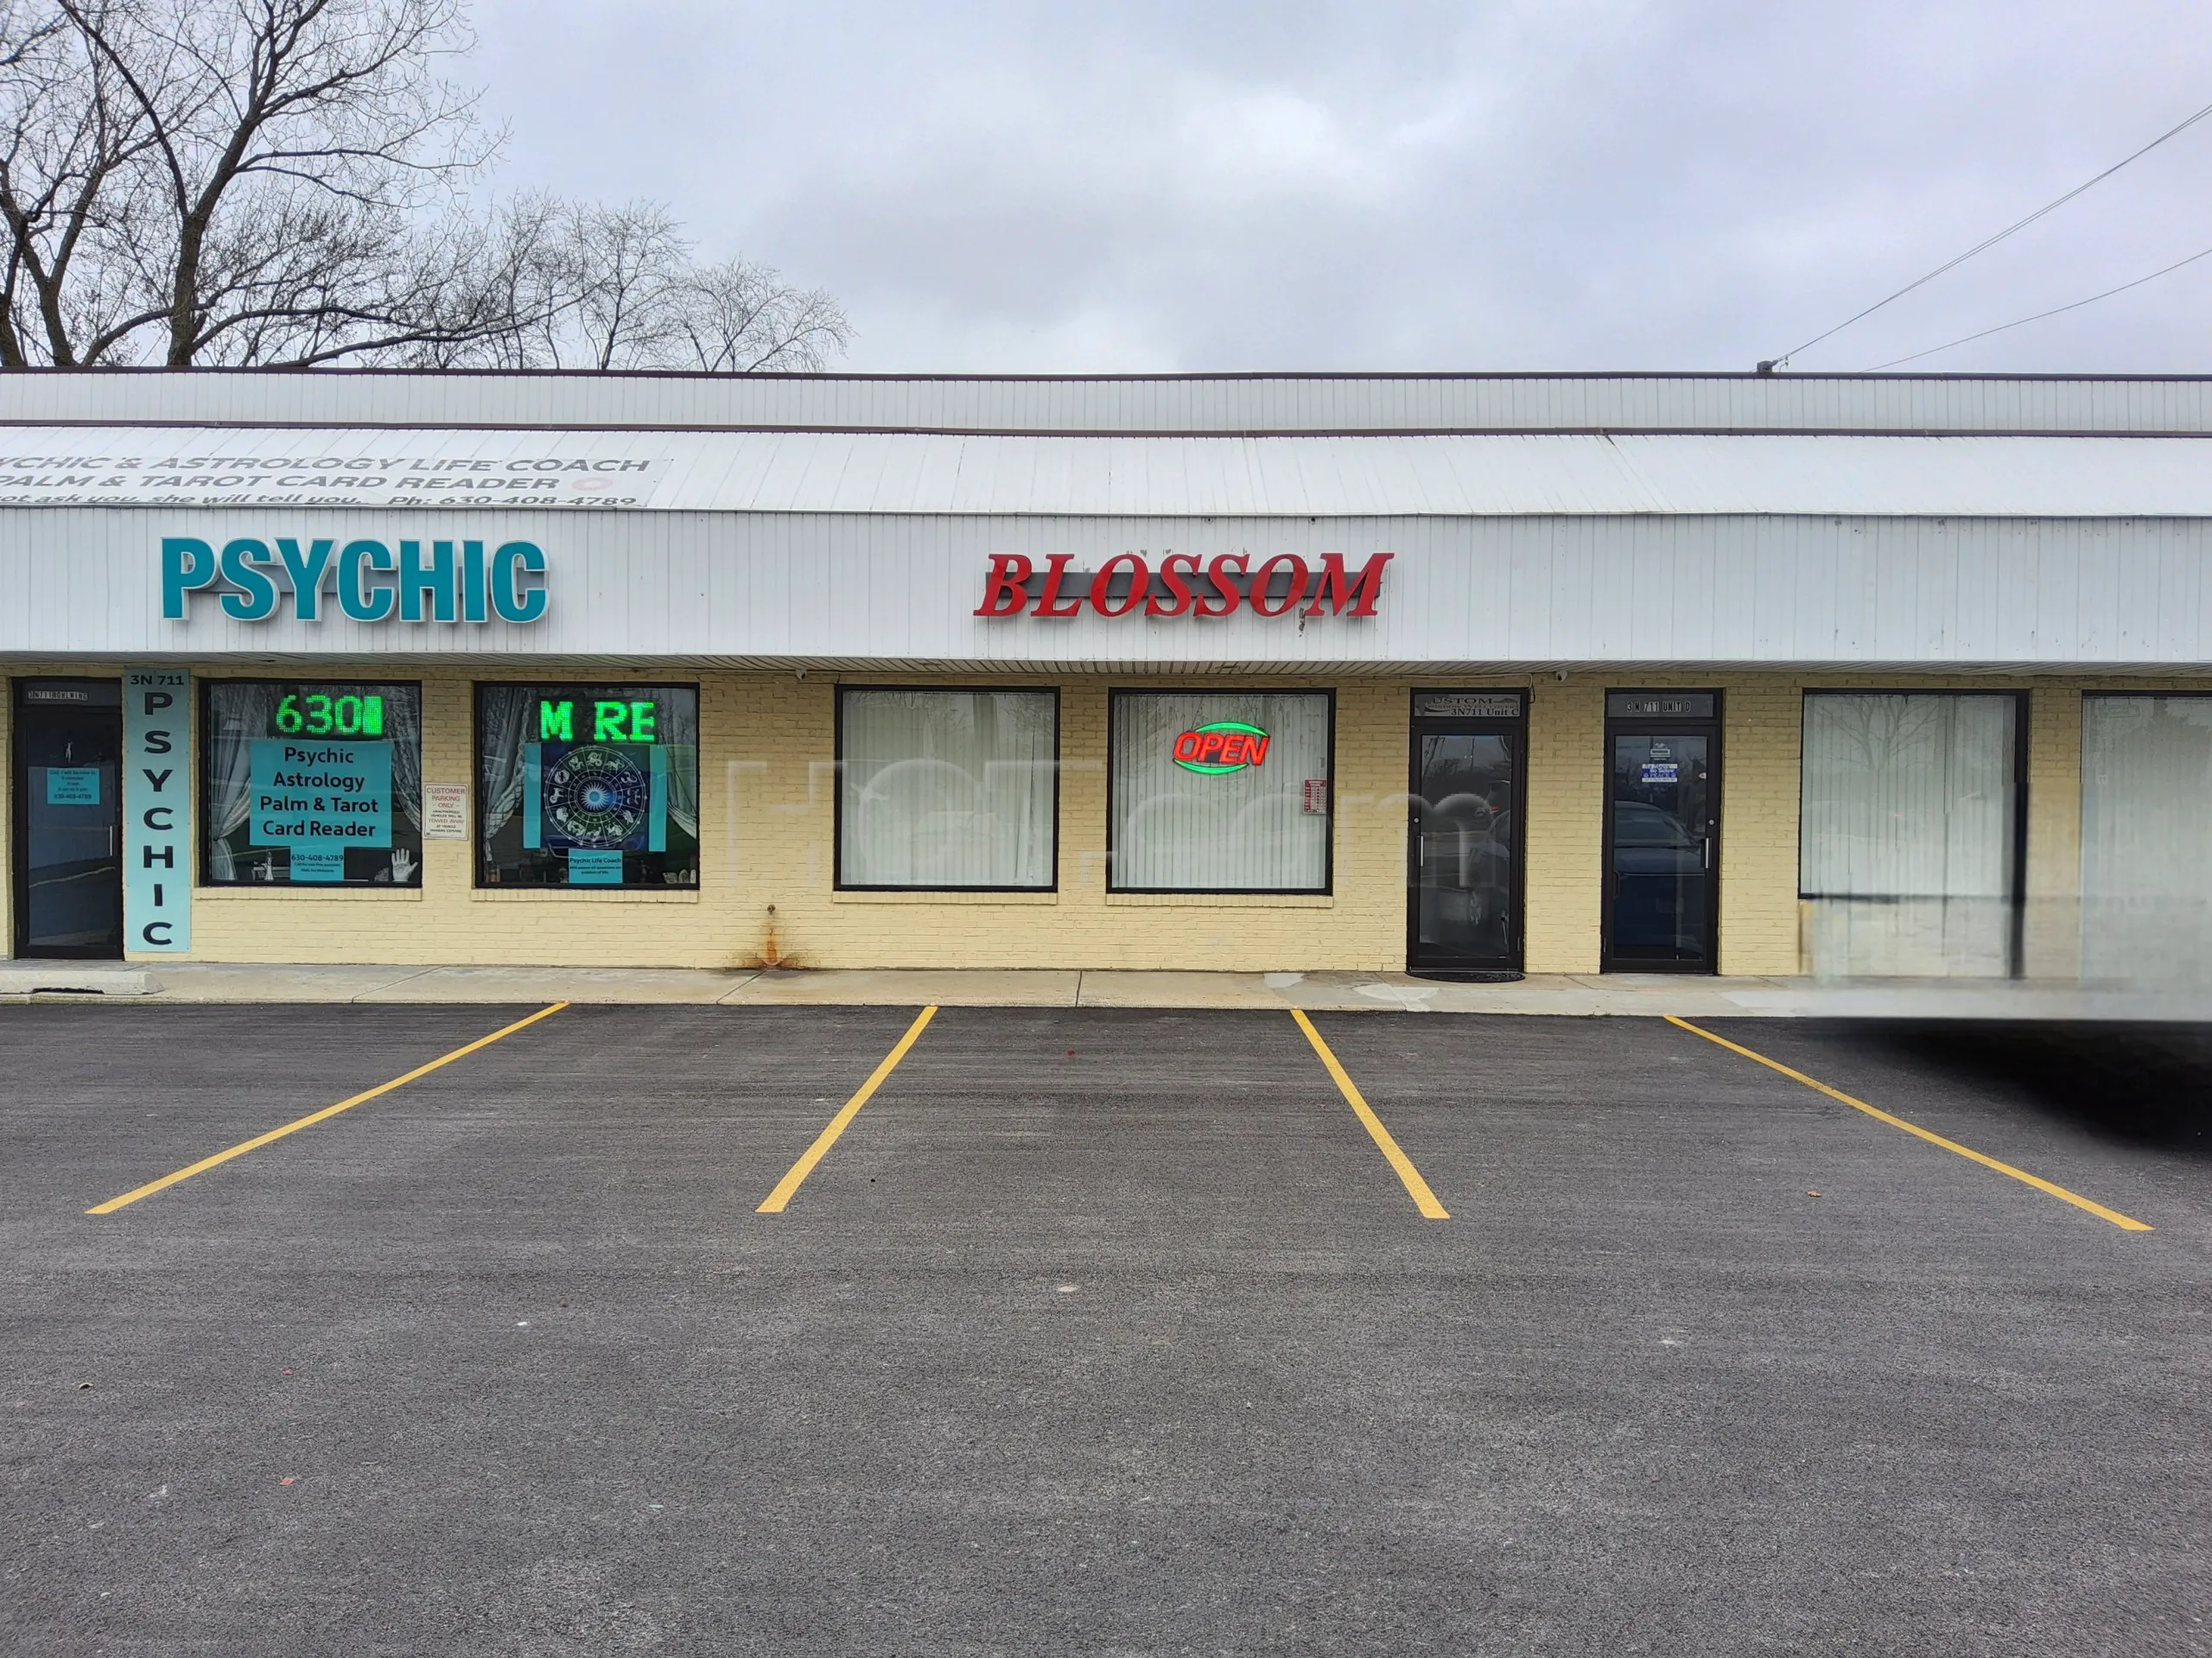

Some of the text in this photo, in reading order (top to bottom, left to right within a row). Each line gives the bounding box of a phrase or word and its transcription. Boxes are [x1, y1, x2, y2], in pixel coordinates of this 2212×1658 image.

[114, 457, 143, 469] &
[147, 457, 405, 470] ASTROLOGY
[409, 459, 499, 472] LIFE
[505, 459, 651, 472] COACH
[98, 475, 127, 486] &
[139, 475, 271, 487] TAROT
[276, 475, 388, 487] CARD
[394, 477, 560, 489] READER
[0, 494, 31, 503] ot
[35, 493, 83, 503] ask
[148, 494, 195, 503] she
[202, 494, 252, 503] will
[256, 493, 303, 503] tell
[389, 496, 431, 505] Ph:
[439, 496, 637, 505] 630-408-4789
[161, 537, 550, 625] PSYCHIC
[973, 552, 1395, 618] BLOSSOM
[130, 676, 184, 685] 3N 711
[1644, 702, 1659, 712] 711
[1663, 702, 1681, 712] UNIT
[1173, 731, 1270, 765] OPEN
[284, 746, 354, 767] Psychic
[273, 772, 365, 792] Astrology
[260, 795, 378, 812] Palm & Tarot
[263, 820, 376, 836] Card Reader
